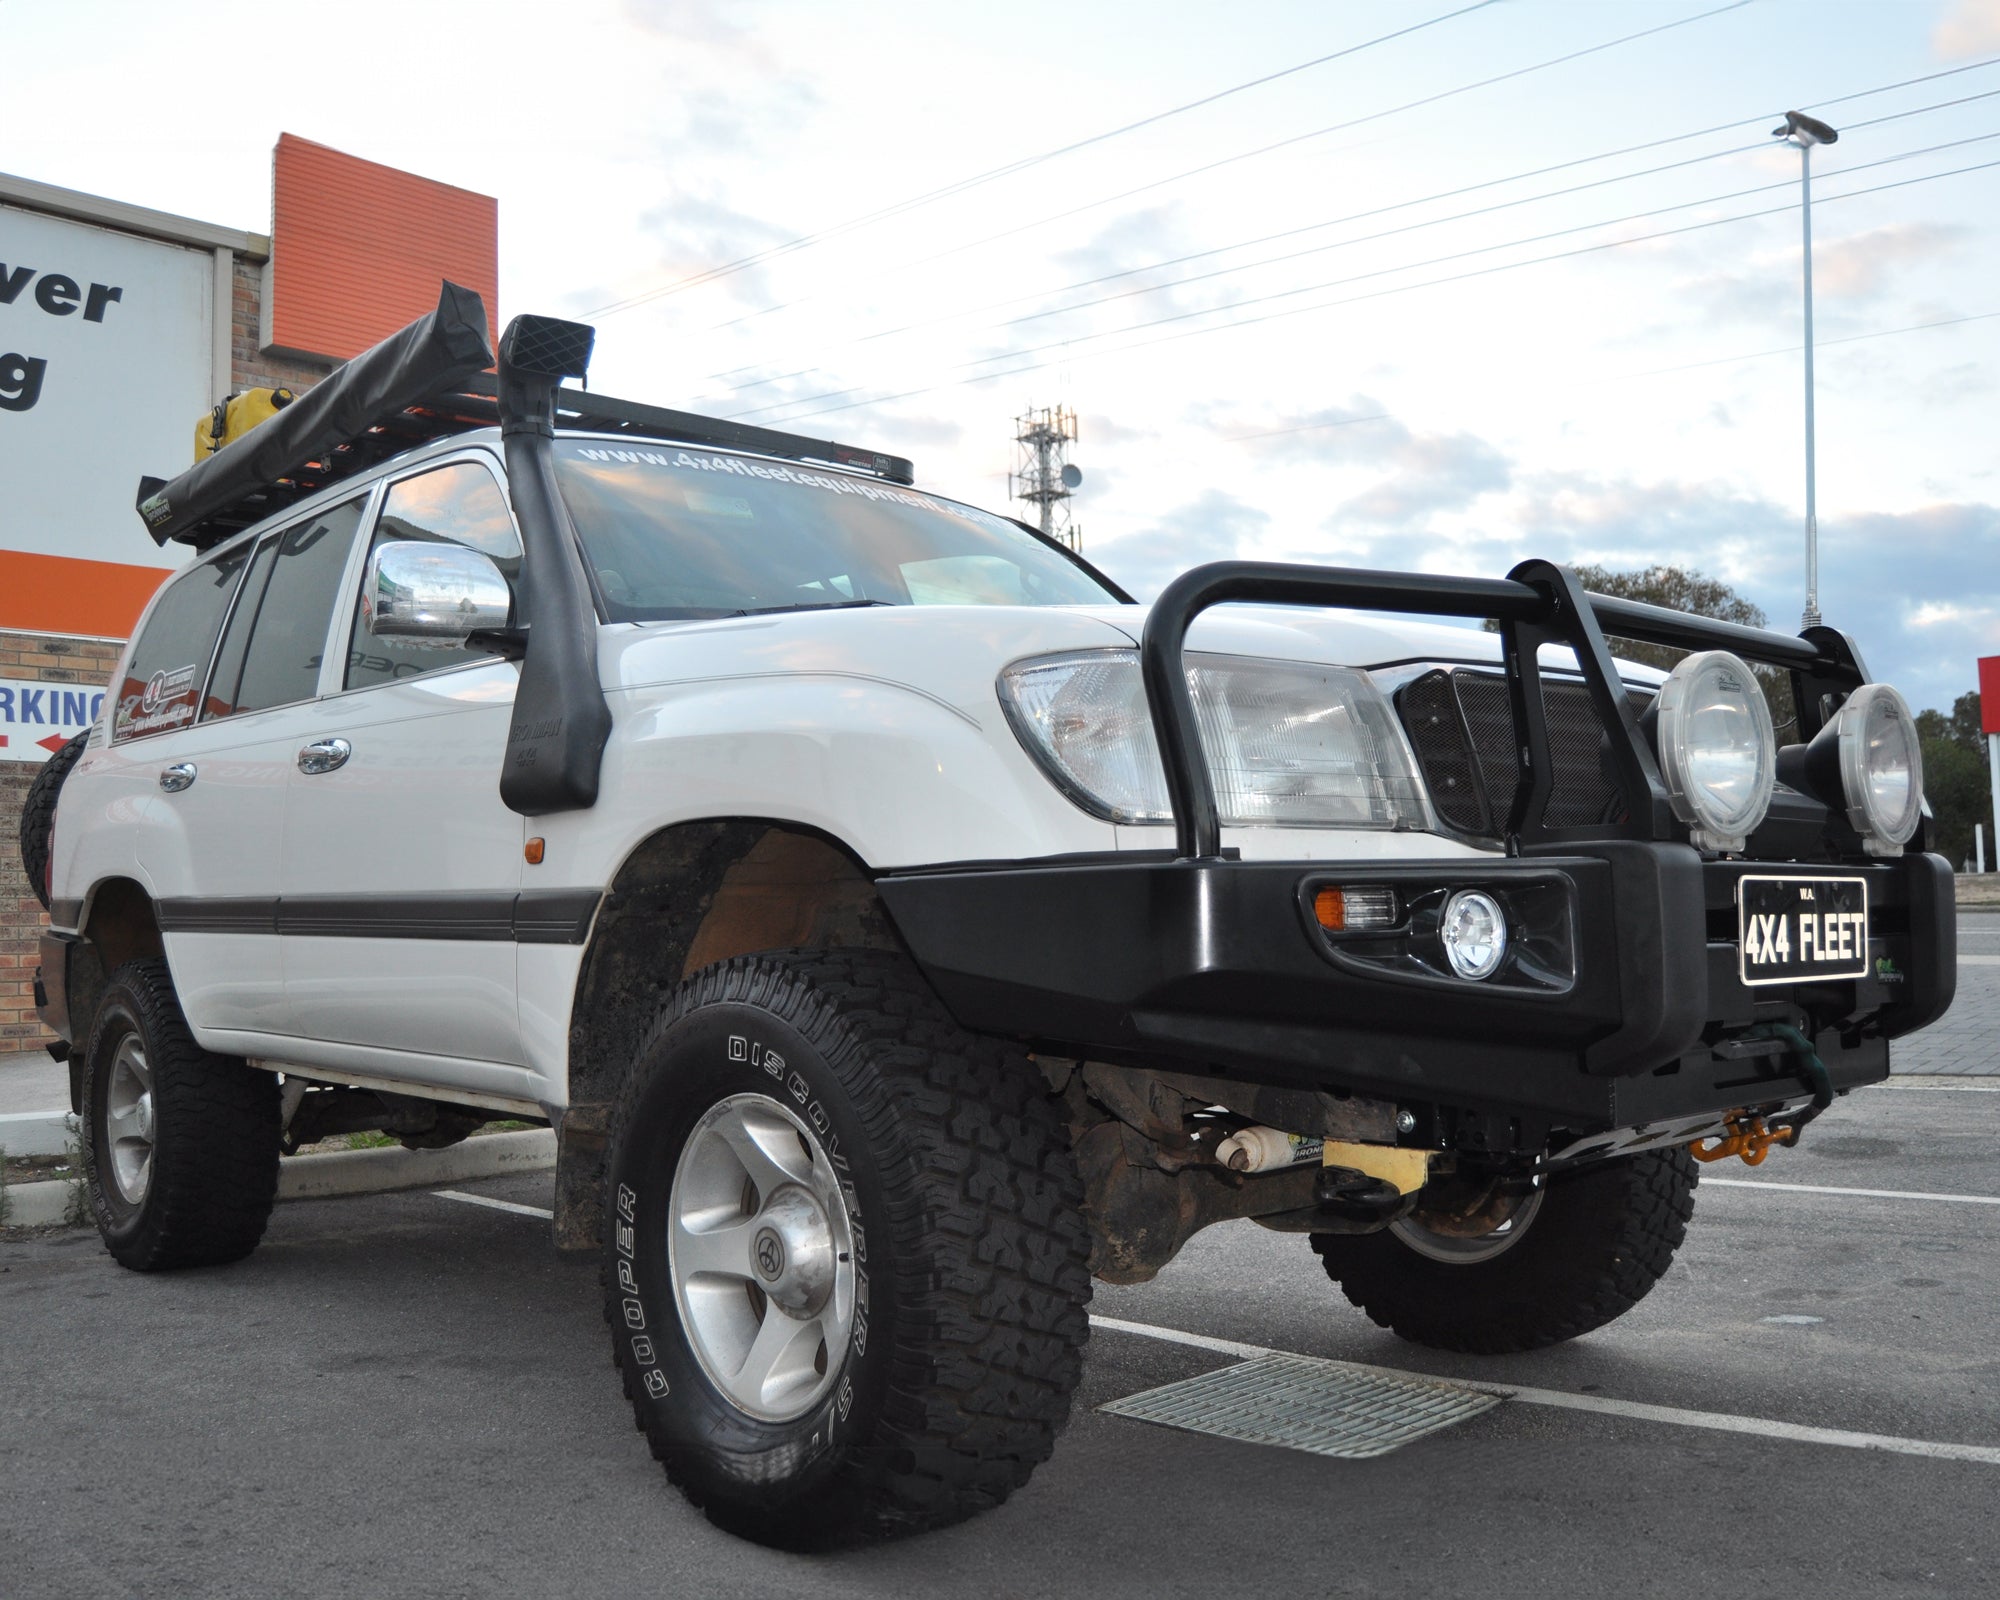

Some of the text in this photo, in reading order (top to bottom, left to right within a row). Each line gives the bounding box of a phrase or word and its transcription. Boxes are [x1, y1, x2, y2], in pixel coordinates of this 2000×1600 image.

[1003, 666, 1058, 679] LANDCRUISER
[1745, 912, 1864, 964] 4X4 FLEET
[728, 1034, 870, 1357] DISCOVERER
[616, 1182, 670, 1400] COOPER
